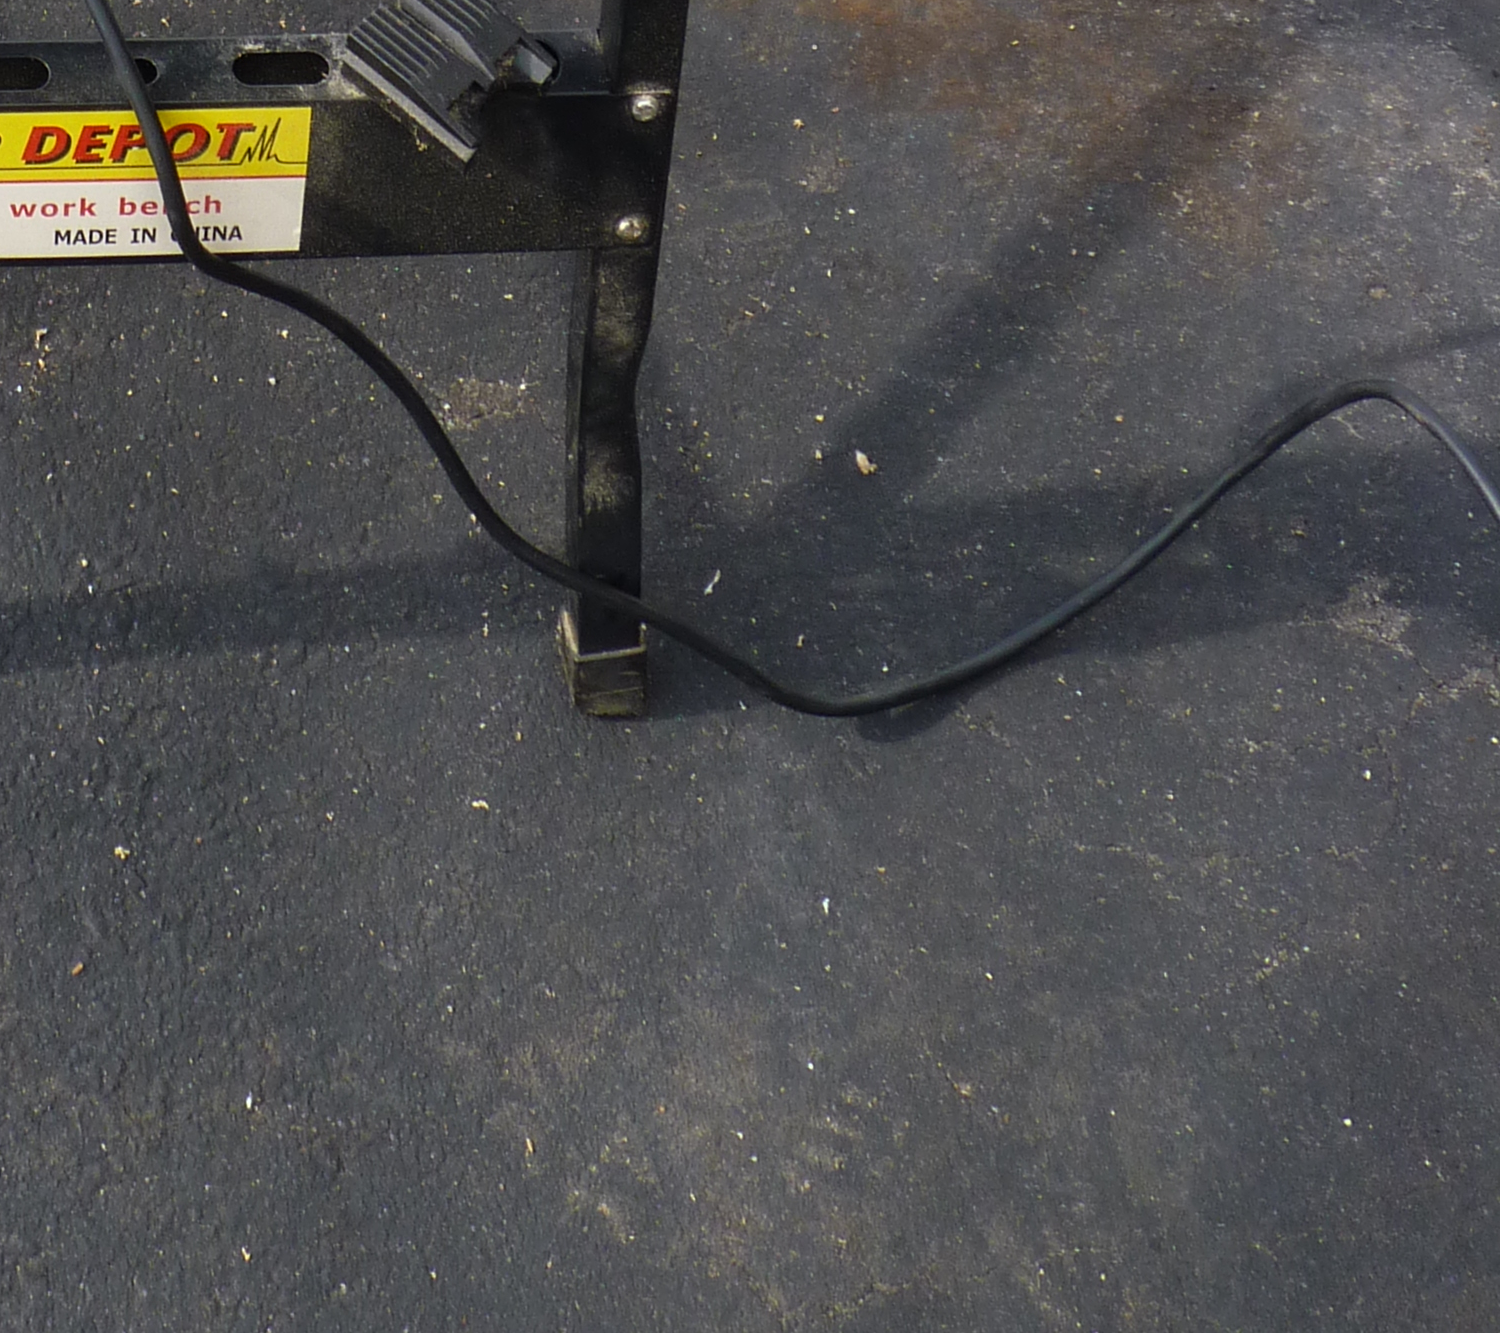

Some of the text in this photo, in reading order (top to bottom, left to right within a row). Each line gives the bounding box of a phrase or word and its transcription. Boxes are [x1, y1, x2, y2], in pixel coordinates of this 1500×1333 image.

[21, 122, 257, 165] DEPOT
[11, 197, 97, 218] work
[119, 195, 222, 216] bech
[54, 228, 117, 245] MADE
[130, 228, 157, 244] IN
